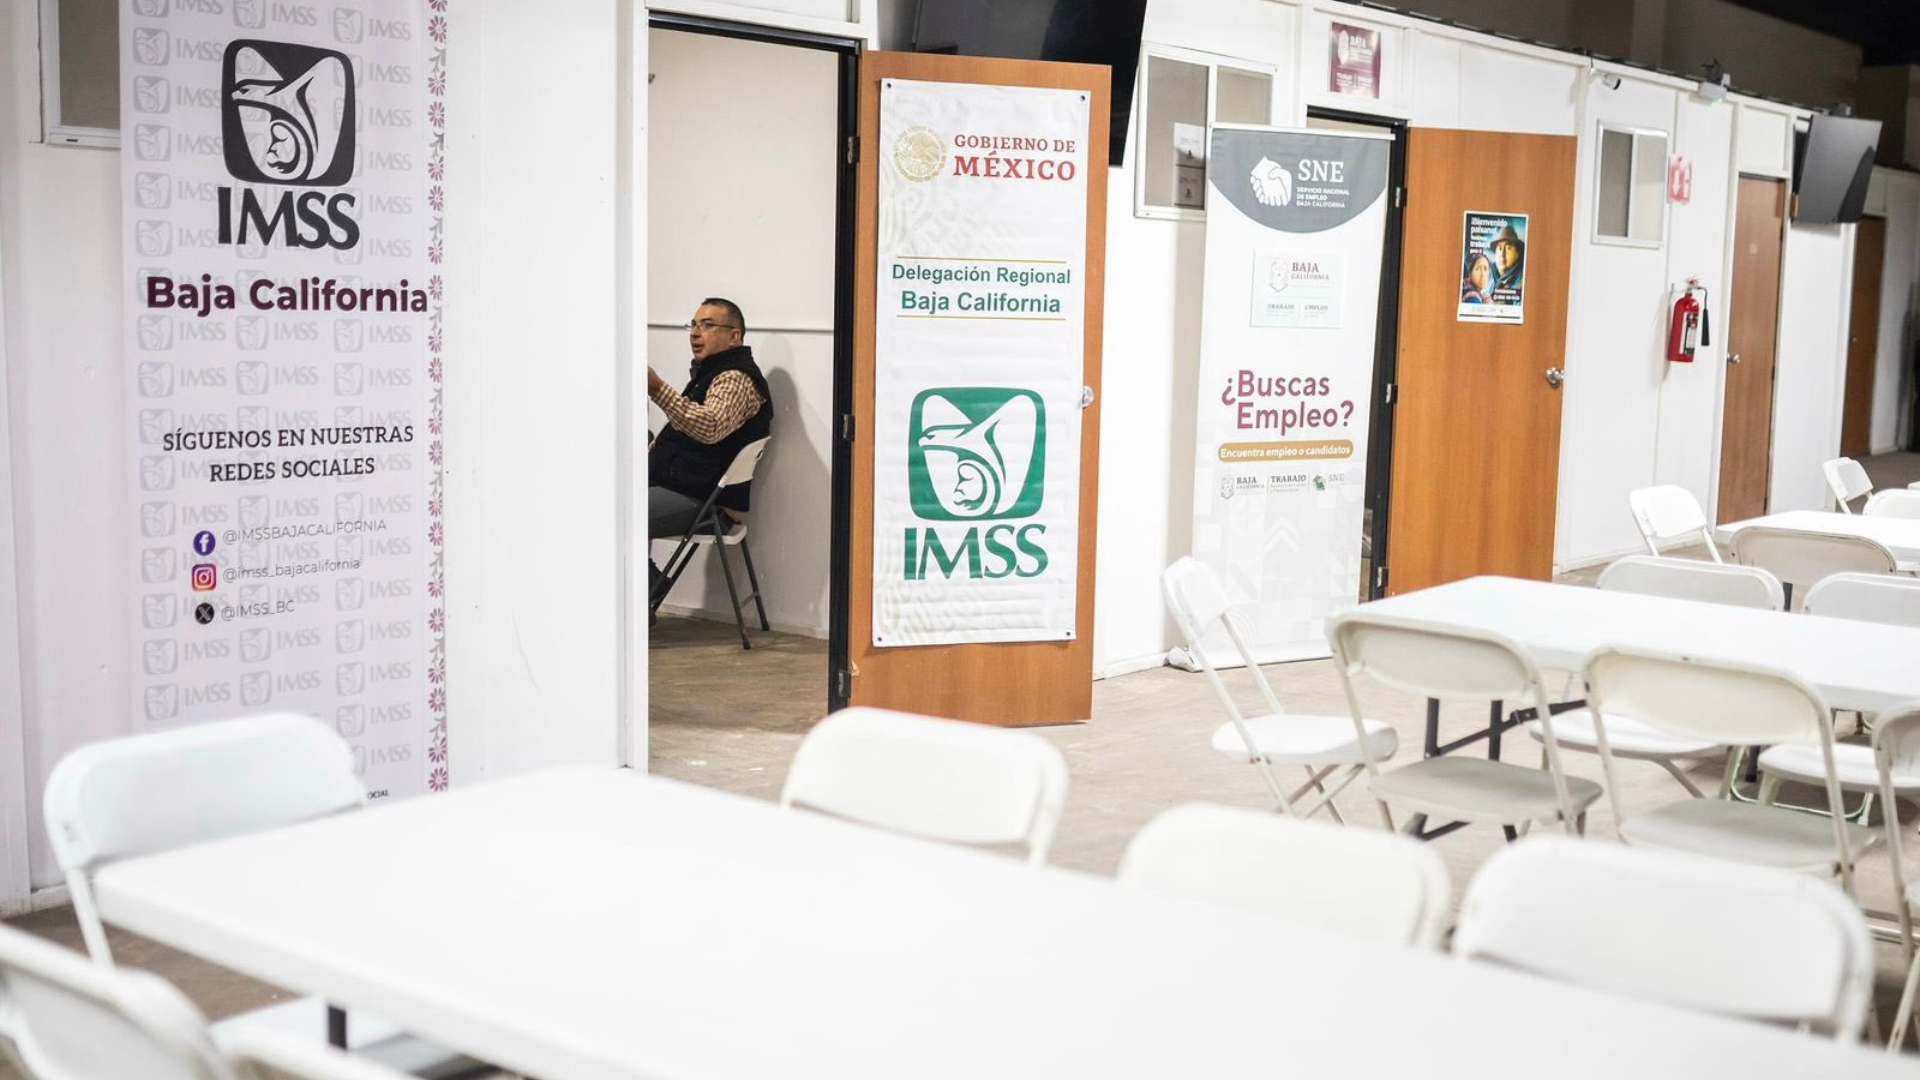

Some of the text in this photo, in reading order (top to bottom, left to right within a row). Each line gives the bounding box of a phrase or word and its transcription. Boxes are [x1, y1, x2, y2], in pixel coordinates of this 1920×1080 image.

[271, 2, 318, 27] IMSS
[368, 18, 412, 41] IMSS
[368, 63, 412, 85] IMSS
[369, 106, 413, 128] IMSS
[954, 134, 1076, 153] GOBIERNO DE
[369, 151, 413, 172] IMSS
[953, 150, 1076, 181] MÉXICO
[1297, 158, 1345, 183] SNE
[369, 194, 413, 215] IMSS
[217, 187, 360, 250] IMSS
[369, 237, 413, 258] IMSS
[892, 264, 1071, 287] Delegación Regional
[1292, 262, 1319, 273] BAJA
[147, 273, 235, 317] Baja
[250, 277, 428, 312] California
[901, 290, 1061, 314] Baja California
[179, 321, 227, 342] IMSS
[273, 321, 319, 342] IMSS
[368, 324, 413, 344] IMSS
[180, 366, 228, 387] IMSS
[274, 366, 320, 386] IMSS
[368, 367, 413, 386] IMSS
[1221, 369, 1330, 406] ¿Buscas
[1236, 400, 1354, 437] Empleo?
[163, 426, 414, 452] SÍGUENOS EN NUESTRAS
[1220, 447, 1265, 459] Encuentra
[1266, 447, 1298, 458] empleo
[1305, 444, 1350, 455] candidatos
[209, 462, 275, 482] REDES
[282, 458, 375, 479] SOCIALES
[182, 503, 229, 525] IMSS
[275, 497, 320, 518] IMSS
[368, 495, 412, 515] IMSS
[223, 520, 387, 546] @IMSSBAJACALIFORNIA
[275, 541, 320, 562] IMSS
[368, 537, 412, 557] IMSS
[903, 523, 1049, 580] IMSS
[223, 559, 361, 583] @imss_bajacalifornia
[369, 579, 413, 600] IMSS
[221, 600, 295, 621] @IMSS_BC
[277, 628, 322, 650] IMSS
[369, 620, 413, 641] IMSS
[183, 639, 231, 662] IMSS
[277, 671, 322, 694] IMSS
[369, 662, 413, 683] IMSS
[184, 683, 232, 706] IMSS
[369, 703, 413, 725] IMSS
[370, 744, 412, 766] IMSS
[368, 789, 389, 799] OCIAL
